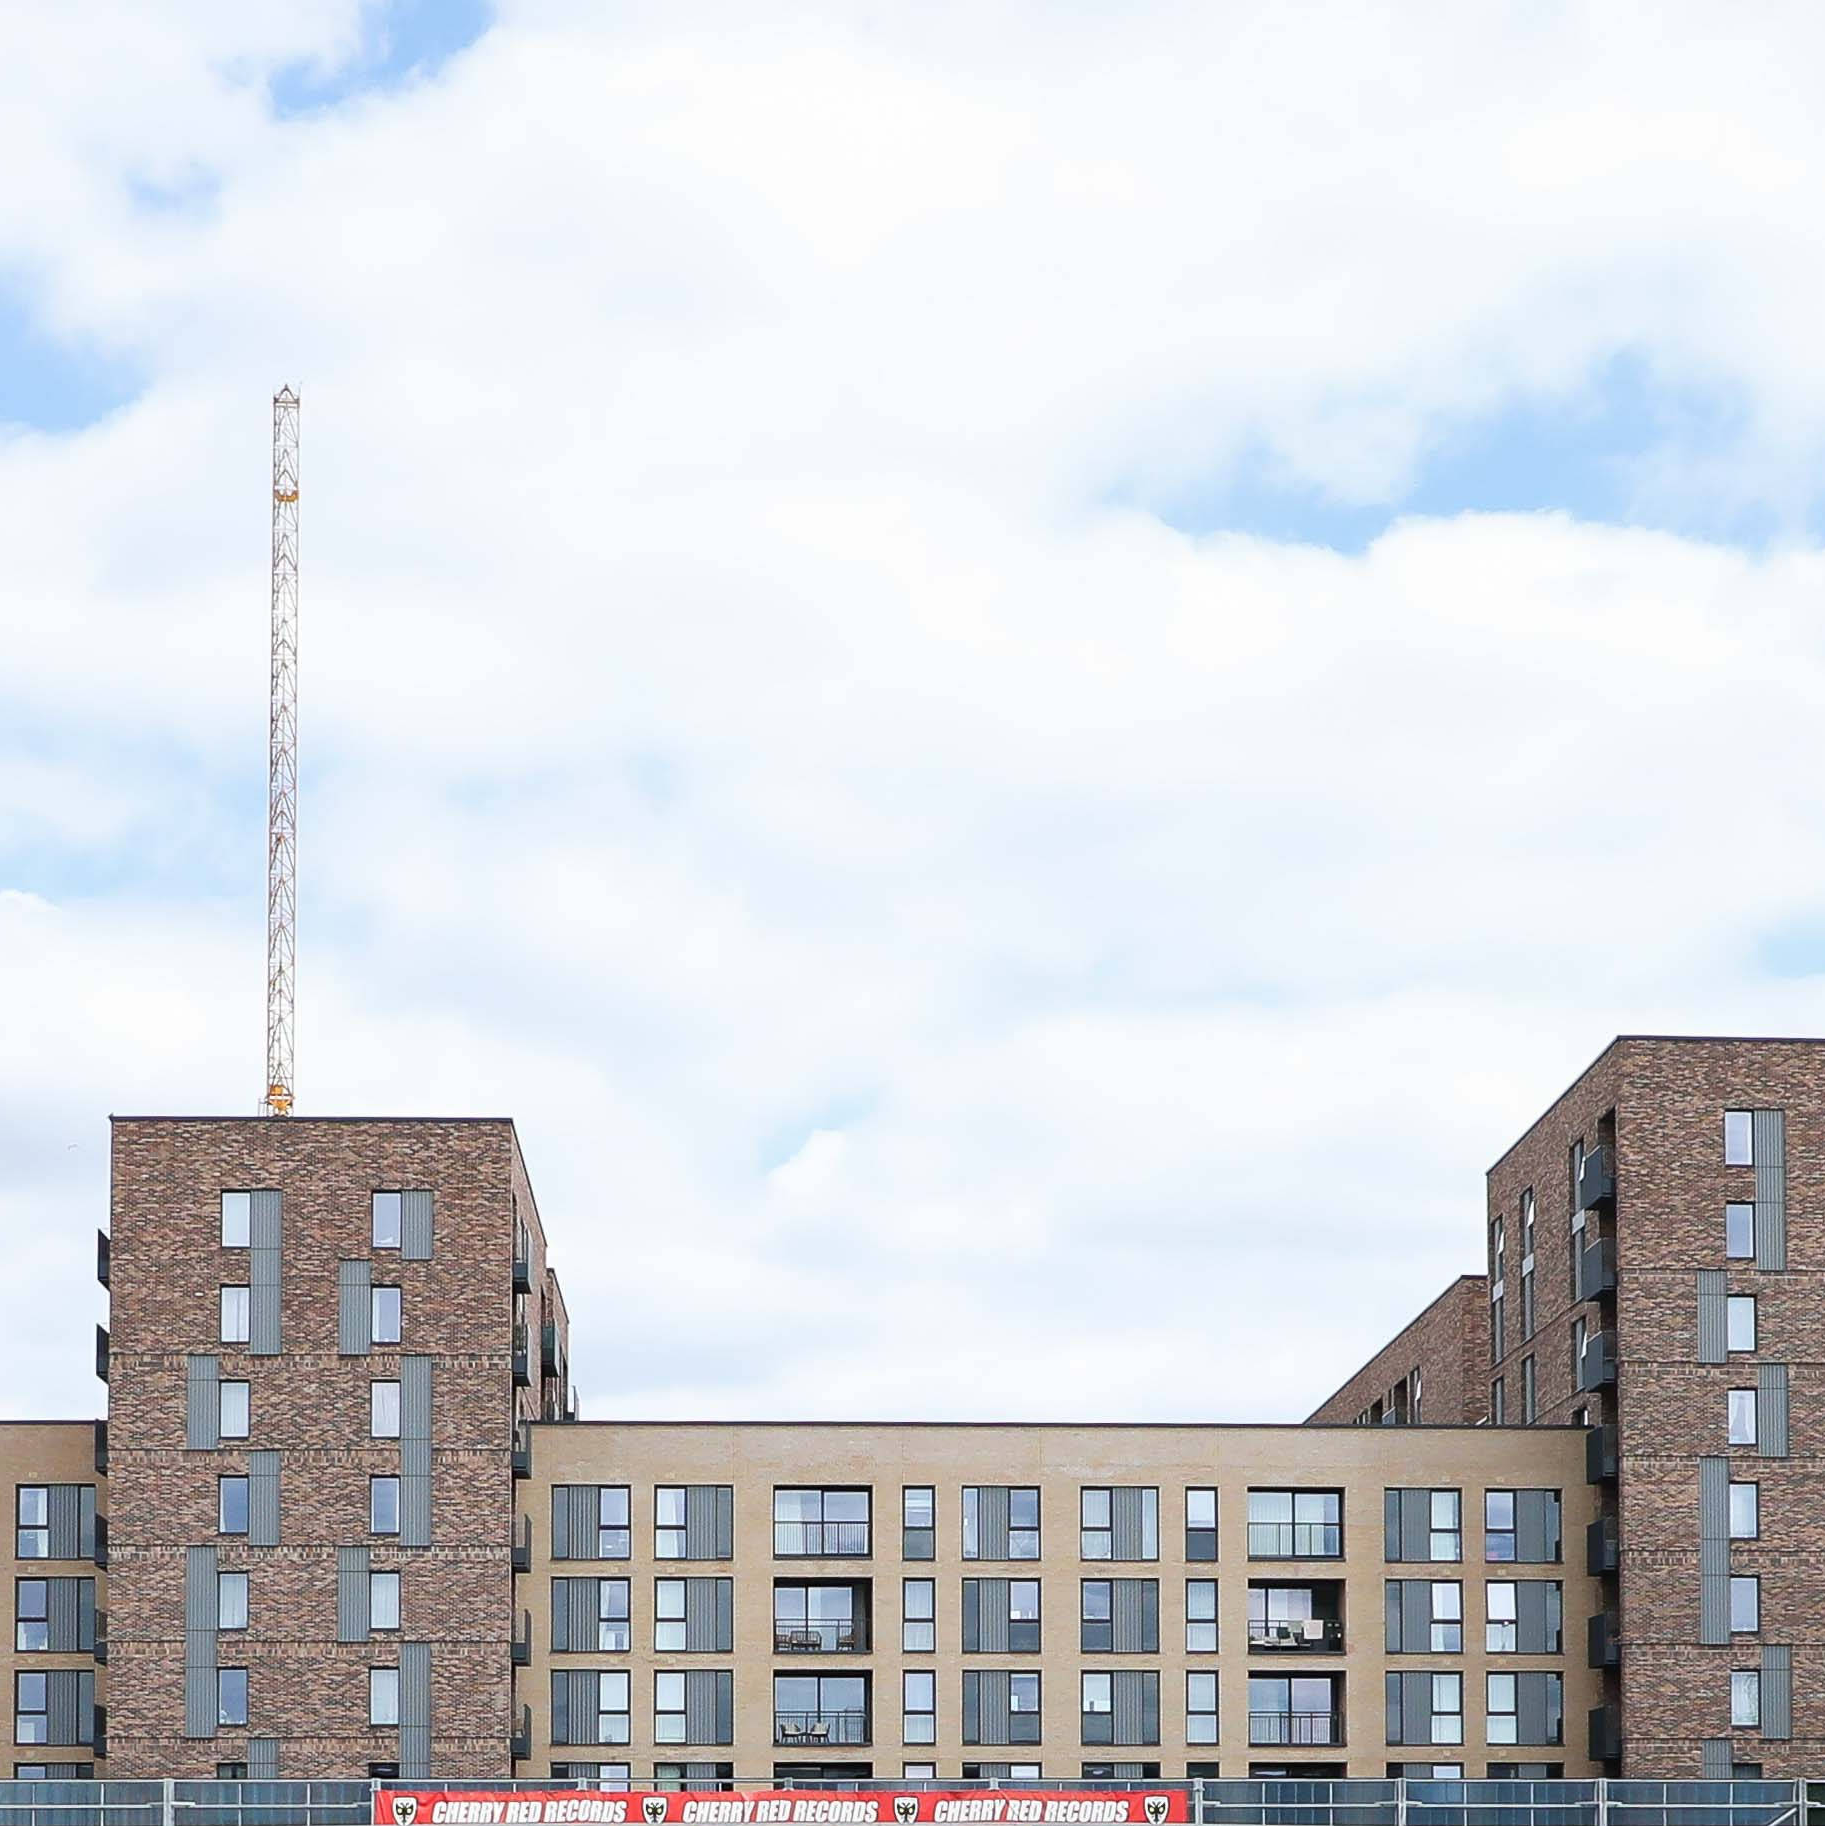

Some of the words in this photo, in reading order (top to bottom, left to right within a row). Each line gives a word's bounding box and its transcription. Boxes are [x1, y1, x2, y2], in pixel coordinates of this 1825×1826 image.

[432, 1801, 505, 1823] CHERRY
[506, 1801, 543, 1823] RED
[544, 1800, 628, 1823] RECORDS
[682, 1801, 757, 1823] CHERRY
[757, 1800, 793, 1822] RED
[793, 1799, 878, 1822] RECORDS
[934, 1799, 1007, 1822] CHERRY
[1006, 1800, 1044, 1822] RED
[1045, 1799, 1129, 1822] RECORDS
